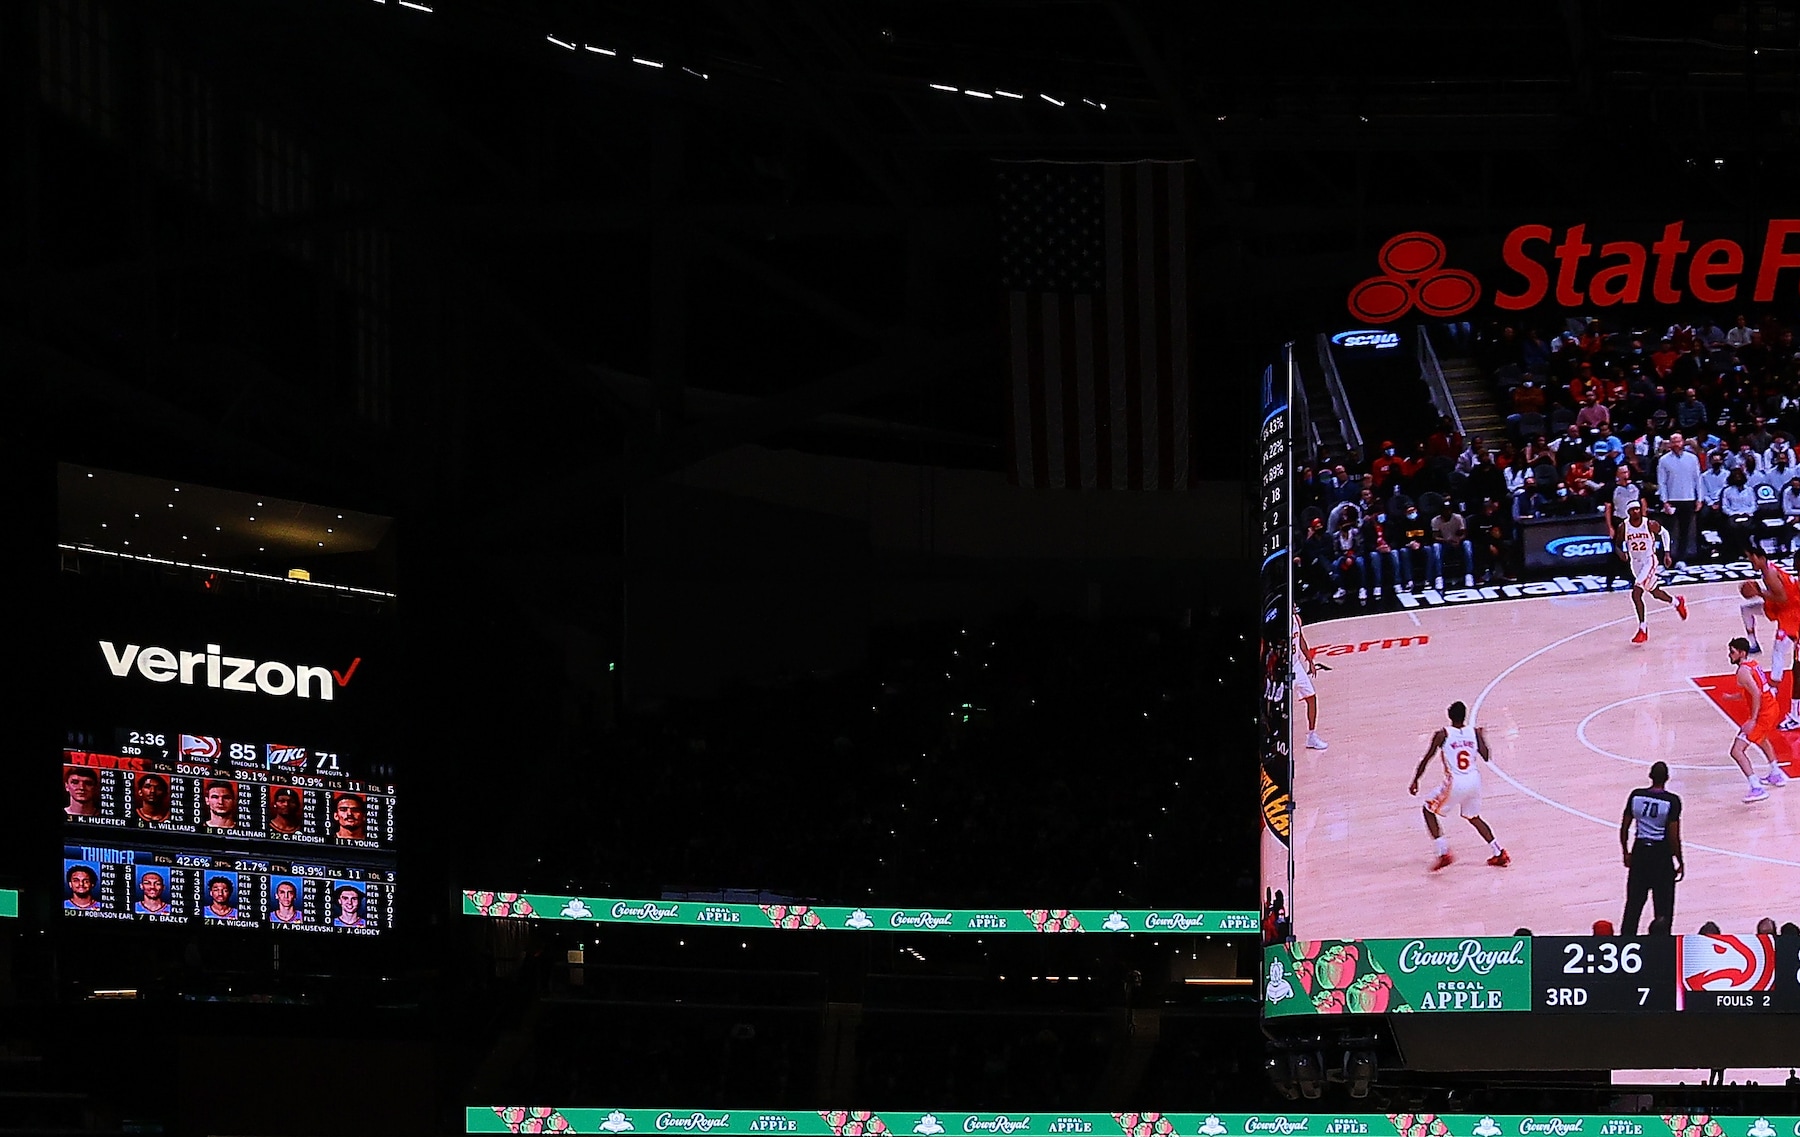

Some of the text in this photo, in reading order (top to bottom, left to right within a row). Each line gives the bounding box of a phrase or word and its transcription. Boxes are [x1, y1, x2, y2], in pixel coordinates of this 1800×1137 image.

[99, 640, 334, 700] verizon
[122, 746, 142, 755] 3RD
[129, 732, 166, 746] 2:36
[229, 743, 256, 761] 85
[269, 748, 306, 764] OKC
[315, 752, 340, 770] 71
[1456, 750, 1470, 772] 6
[176, 764, 211, 776] 50.0%
[234, 770, 268, 782] 39.1%
[291, 776, 324, 787] 90.9%
[176, 857, 211, 867] 42.6%
[234, 861, 268, 872] 21.7%
[291, 865, 324, 877] 88.9%
[612, 903, 678, 922] Crown Royal
[698, 912, 740, 922] APPLE
[1400, 939, 1524, 975] Crown Royal
[1563, 943, 1643, 974] 2:36
[1437, 981, 1485, 990] REGAL
[1420, 991, 1503, 1010] APPLE
[1545, 988, 1650, 1006] 3RD 7
[1716, 995, 1770, 1007] FOULS 2
[656, 1113, 729, 1133] Crown Royal
[750, 1120, 796, 1131] APPLE
